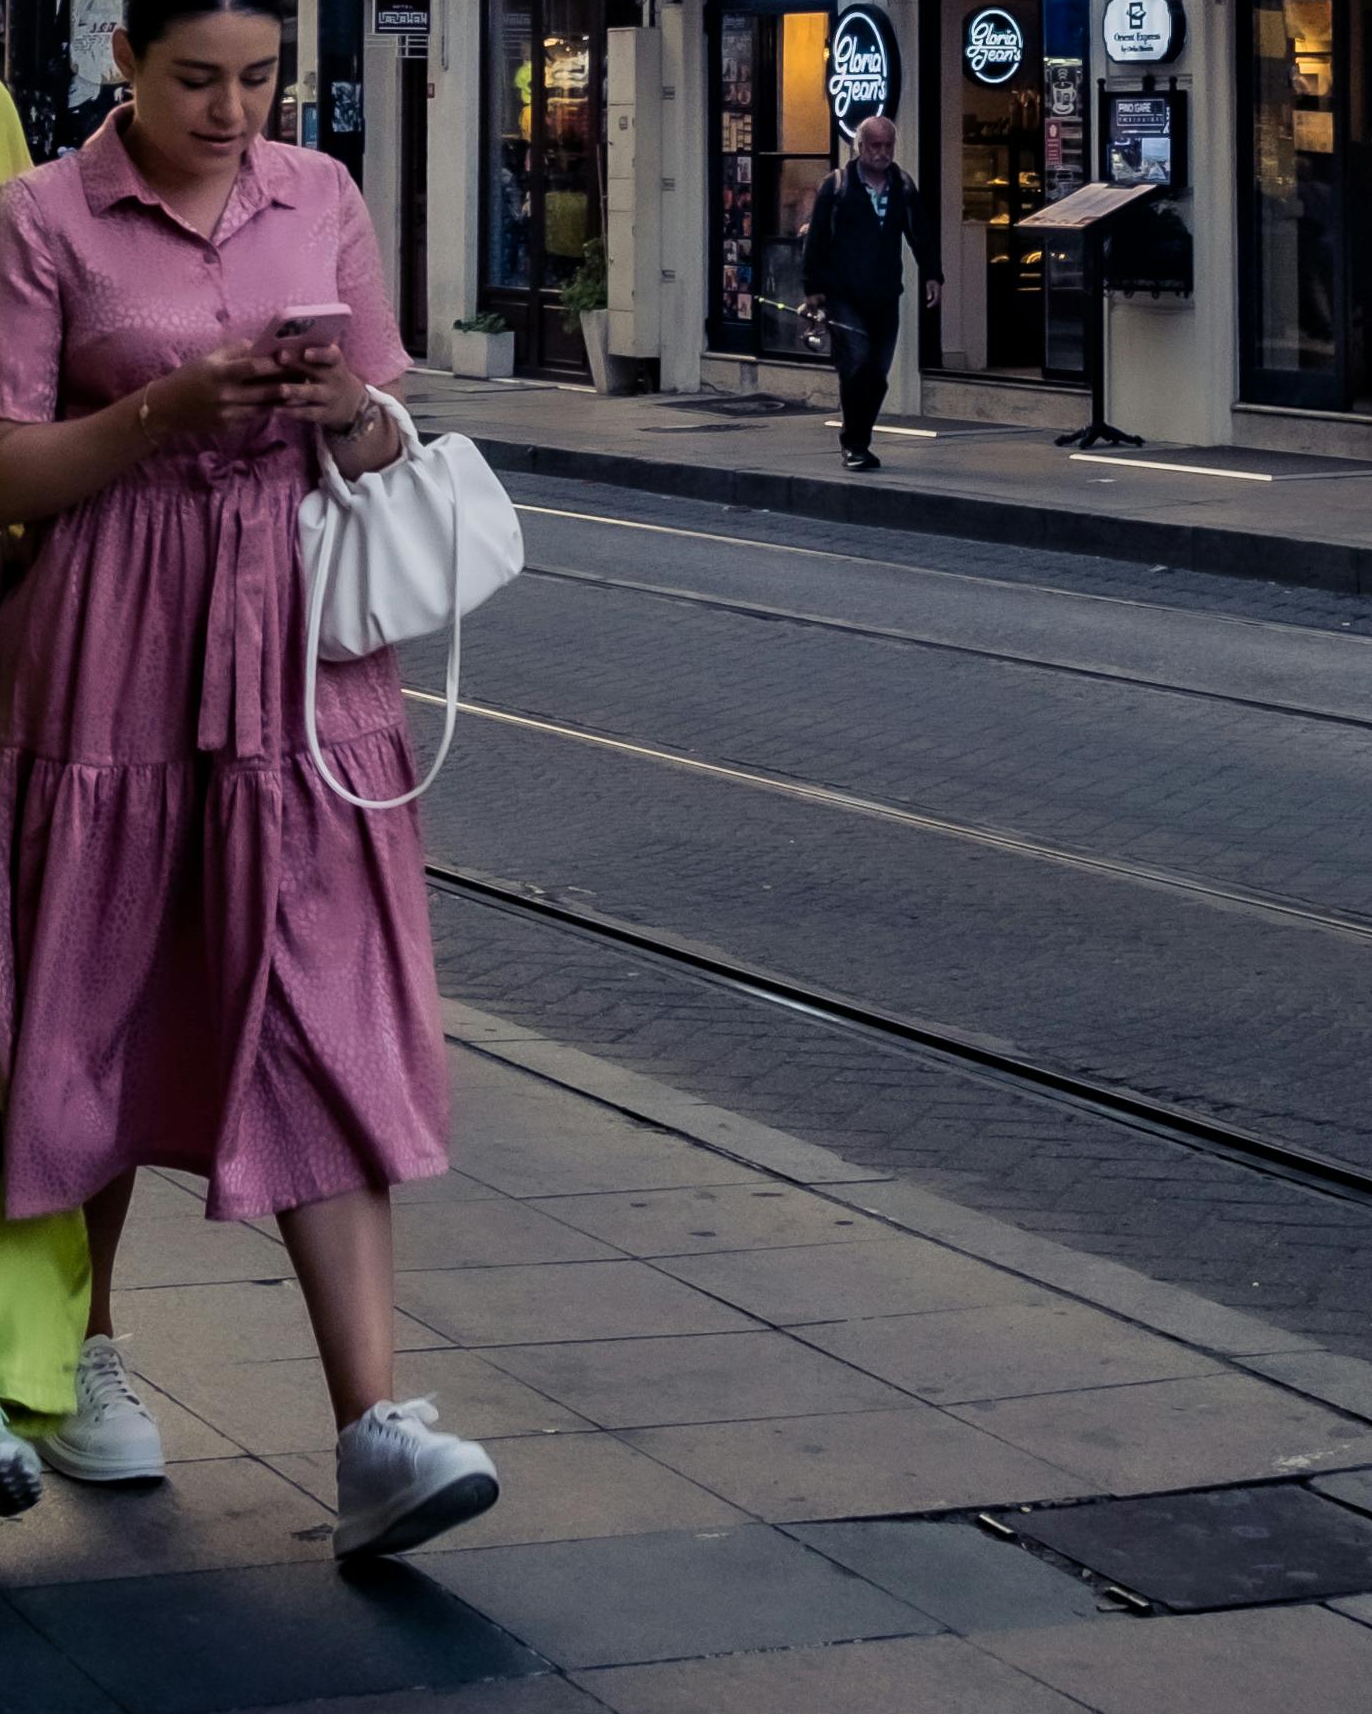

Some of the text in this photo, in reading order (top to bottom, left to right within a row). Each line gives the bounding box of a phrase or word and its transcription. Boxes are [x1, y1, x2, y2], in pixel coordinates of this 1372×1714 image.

[965, 22, 1017, 58] Gloria
[829, 36, 883, 94] Gloria
[971, 49, 1022, 71] Jean's
[835, 78, 887, 117] Jean's
